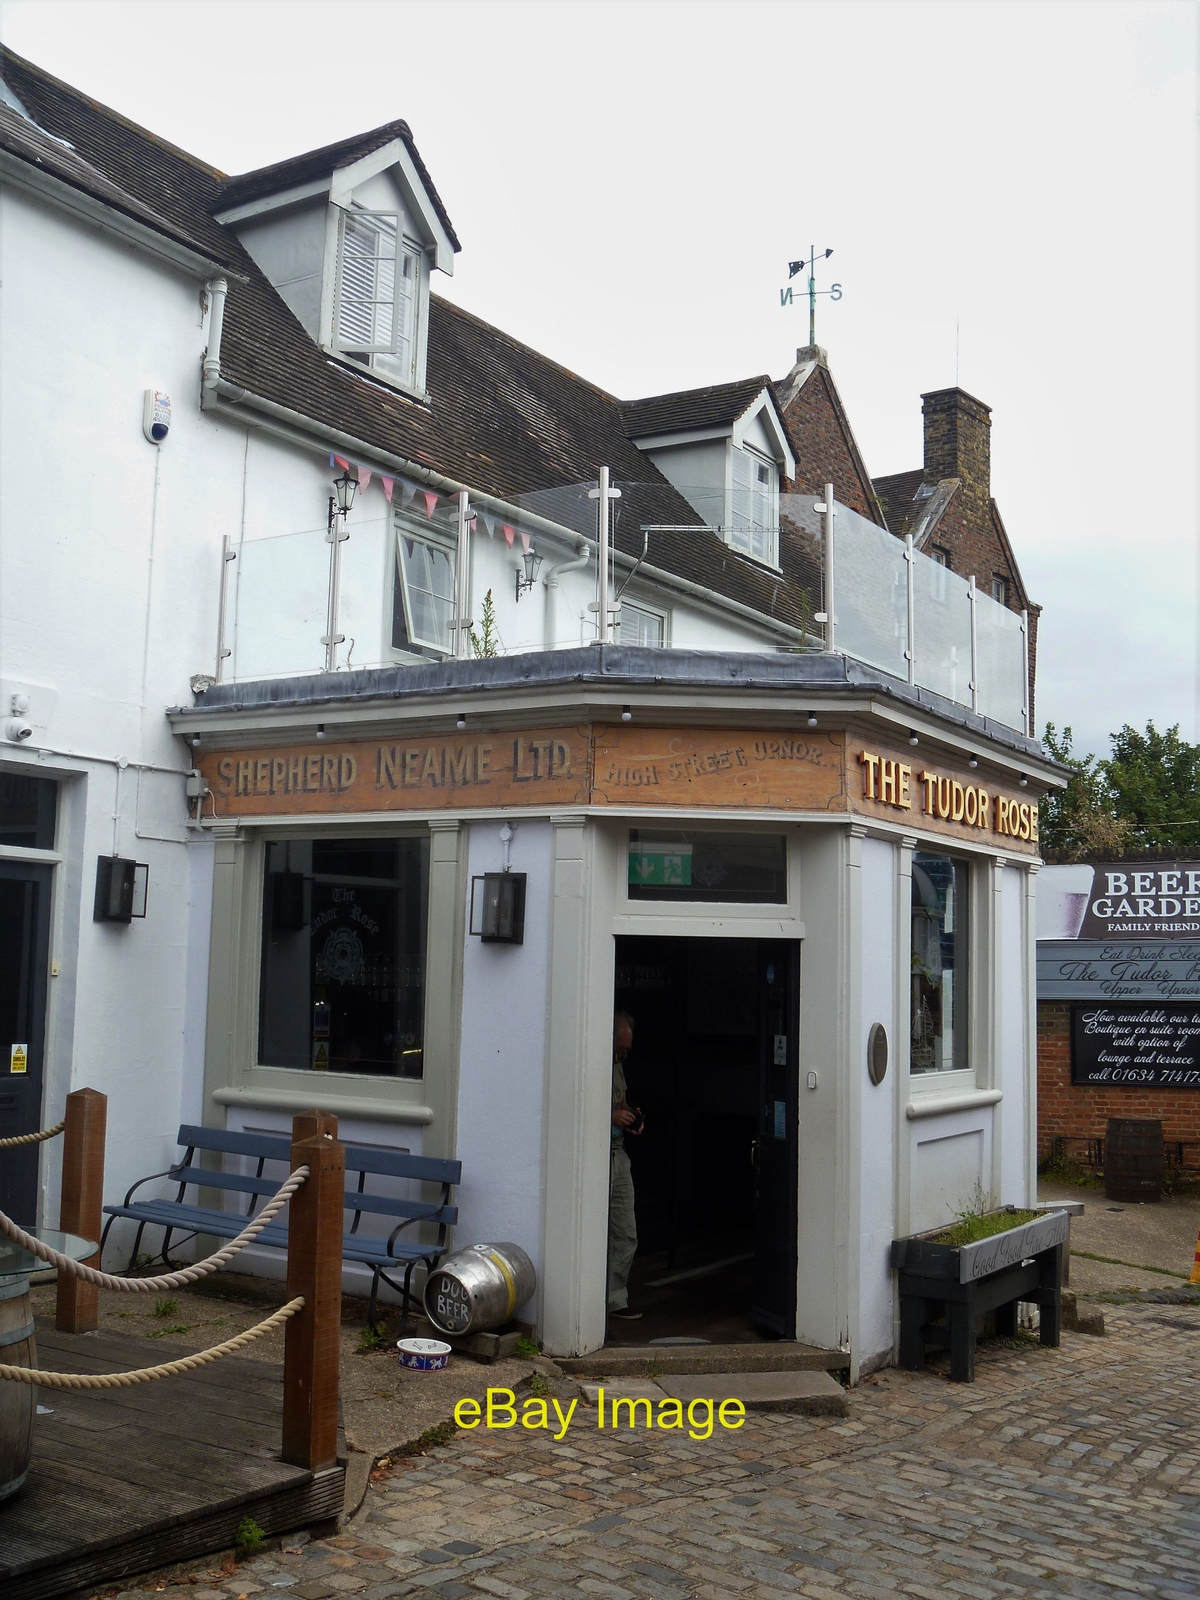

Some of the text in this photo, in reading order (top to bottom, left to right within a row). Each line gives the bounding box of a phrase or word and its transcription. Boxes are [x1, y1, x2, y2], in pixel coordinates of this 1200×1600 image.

[217, 753, 357, 798] SHEPHERD
[375, 743, 494, 790] NEAME
[858, 750, 1039, 842] THE TUDOR ROSE
[331, 888, 356, 904] The
[349, 904, 380, 935] Rose
[1107, 923, 1152, 931] FAMILY
[1100, 946, 1122, 960] Eat
[1127, 946, 1165, 960] Drink
[1059, 961, 1099, 981] The
[1111, 961, 1172, 981] Tudor
[1100, 980, 1143, 999] Upper
[1082, 1010, 1115, 1023] Now
[1118, 1010, 1167, 1023] available
[1084, 1021, 1132, 1038] Boutique
[1149, 1025, 1174, 1035] suite
[1113, 1034, 1188, 1052] with option of
[1097, 1050, 1194, 1067] lounge and terrace
[1088, 1067, 1200, 1082] call 01634 71417
[972, 1240, 1001, 1277] Good
[1000, 1230, 1025, 1266] Food
[441, 1277, 470, 1302] DOG
[437, 1294, 470, 1322] BEER
